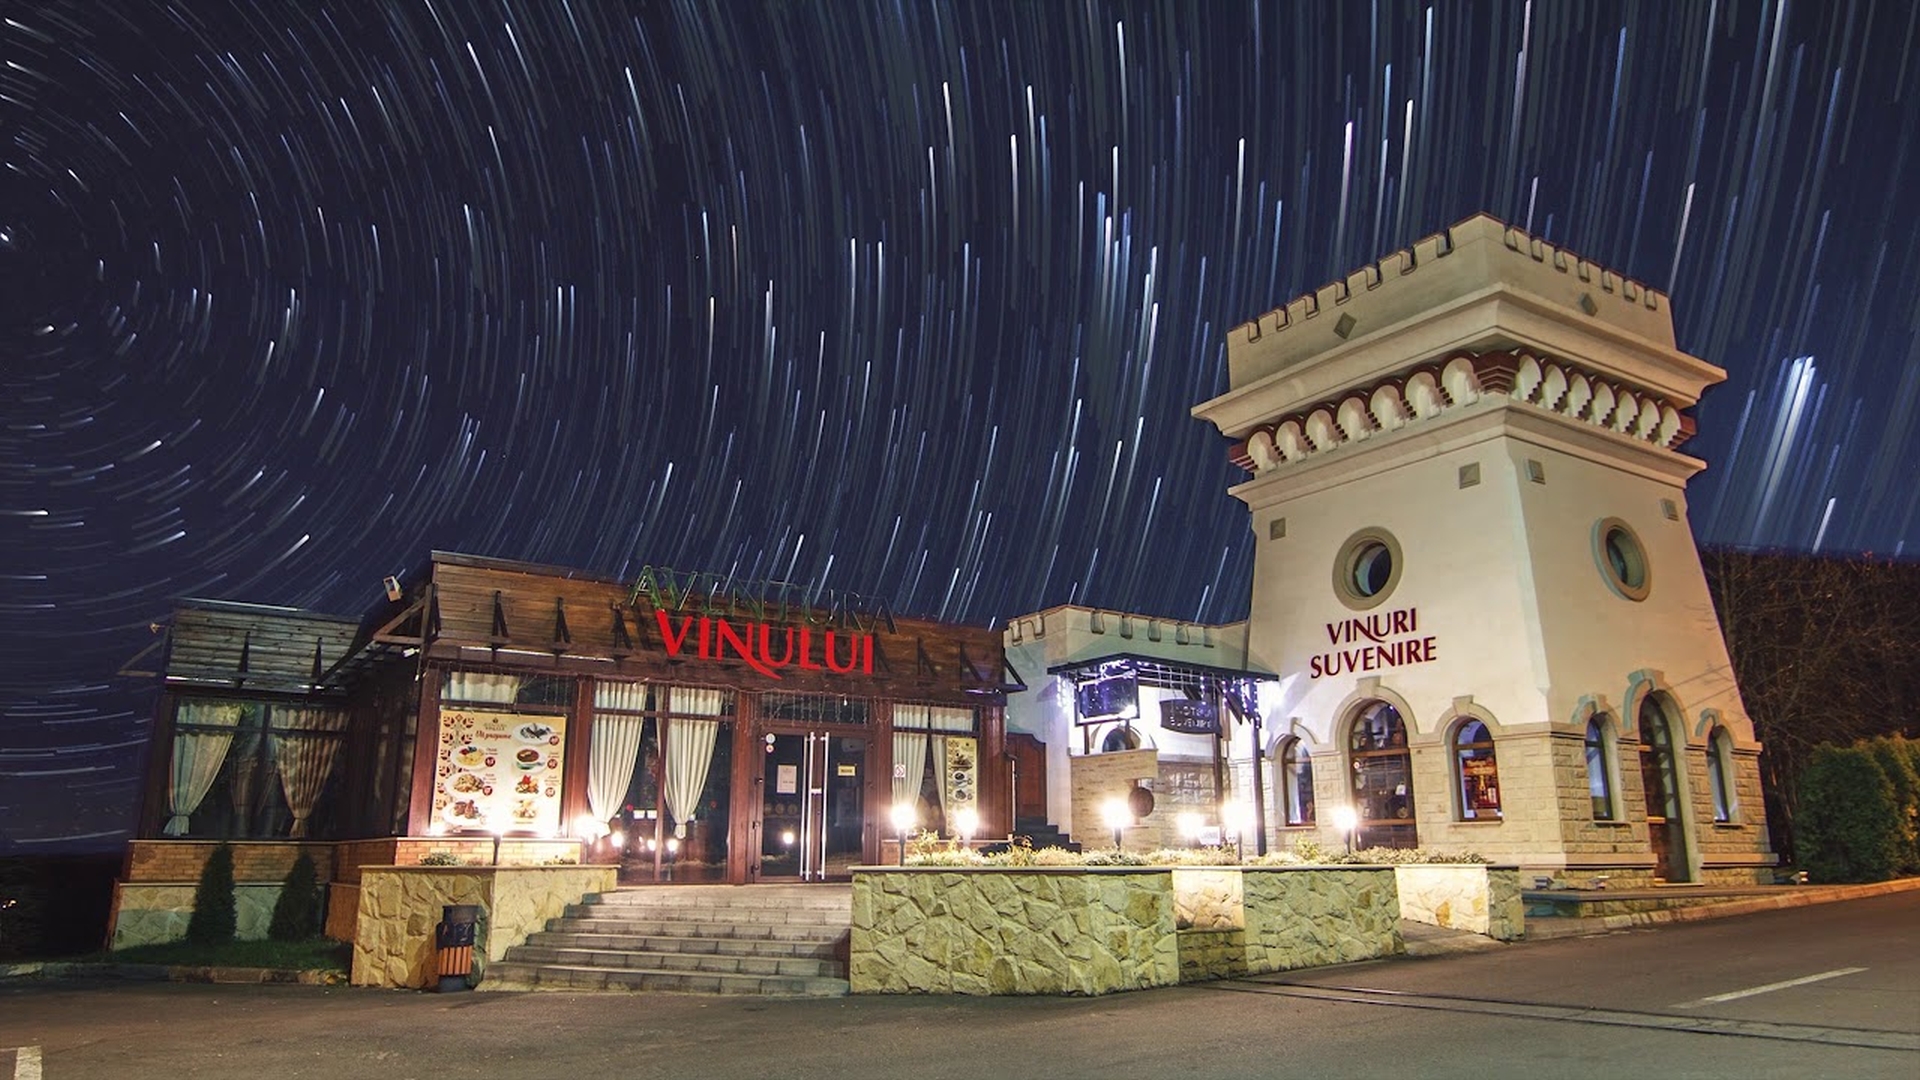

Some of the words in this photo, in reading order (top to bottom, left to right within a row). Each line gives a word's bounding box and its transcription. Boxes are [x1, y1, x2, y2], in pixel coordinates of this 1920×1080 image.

[656, 609, 874, 680] VINULUI
[1326, 608, 1417, 645] VINURI
[1310, 636, 1437, 679] SUVENIRE
